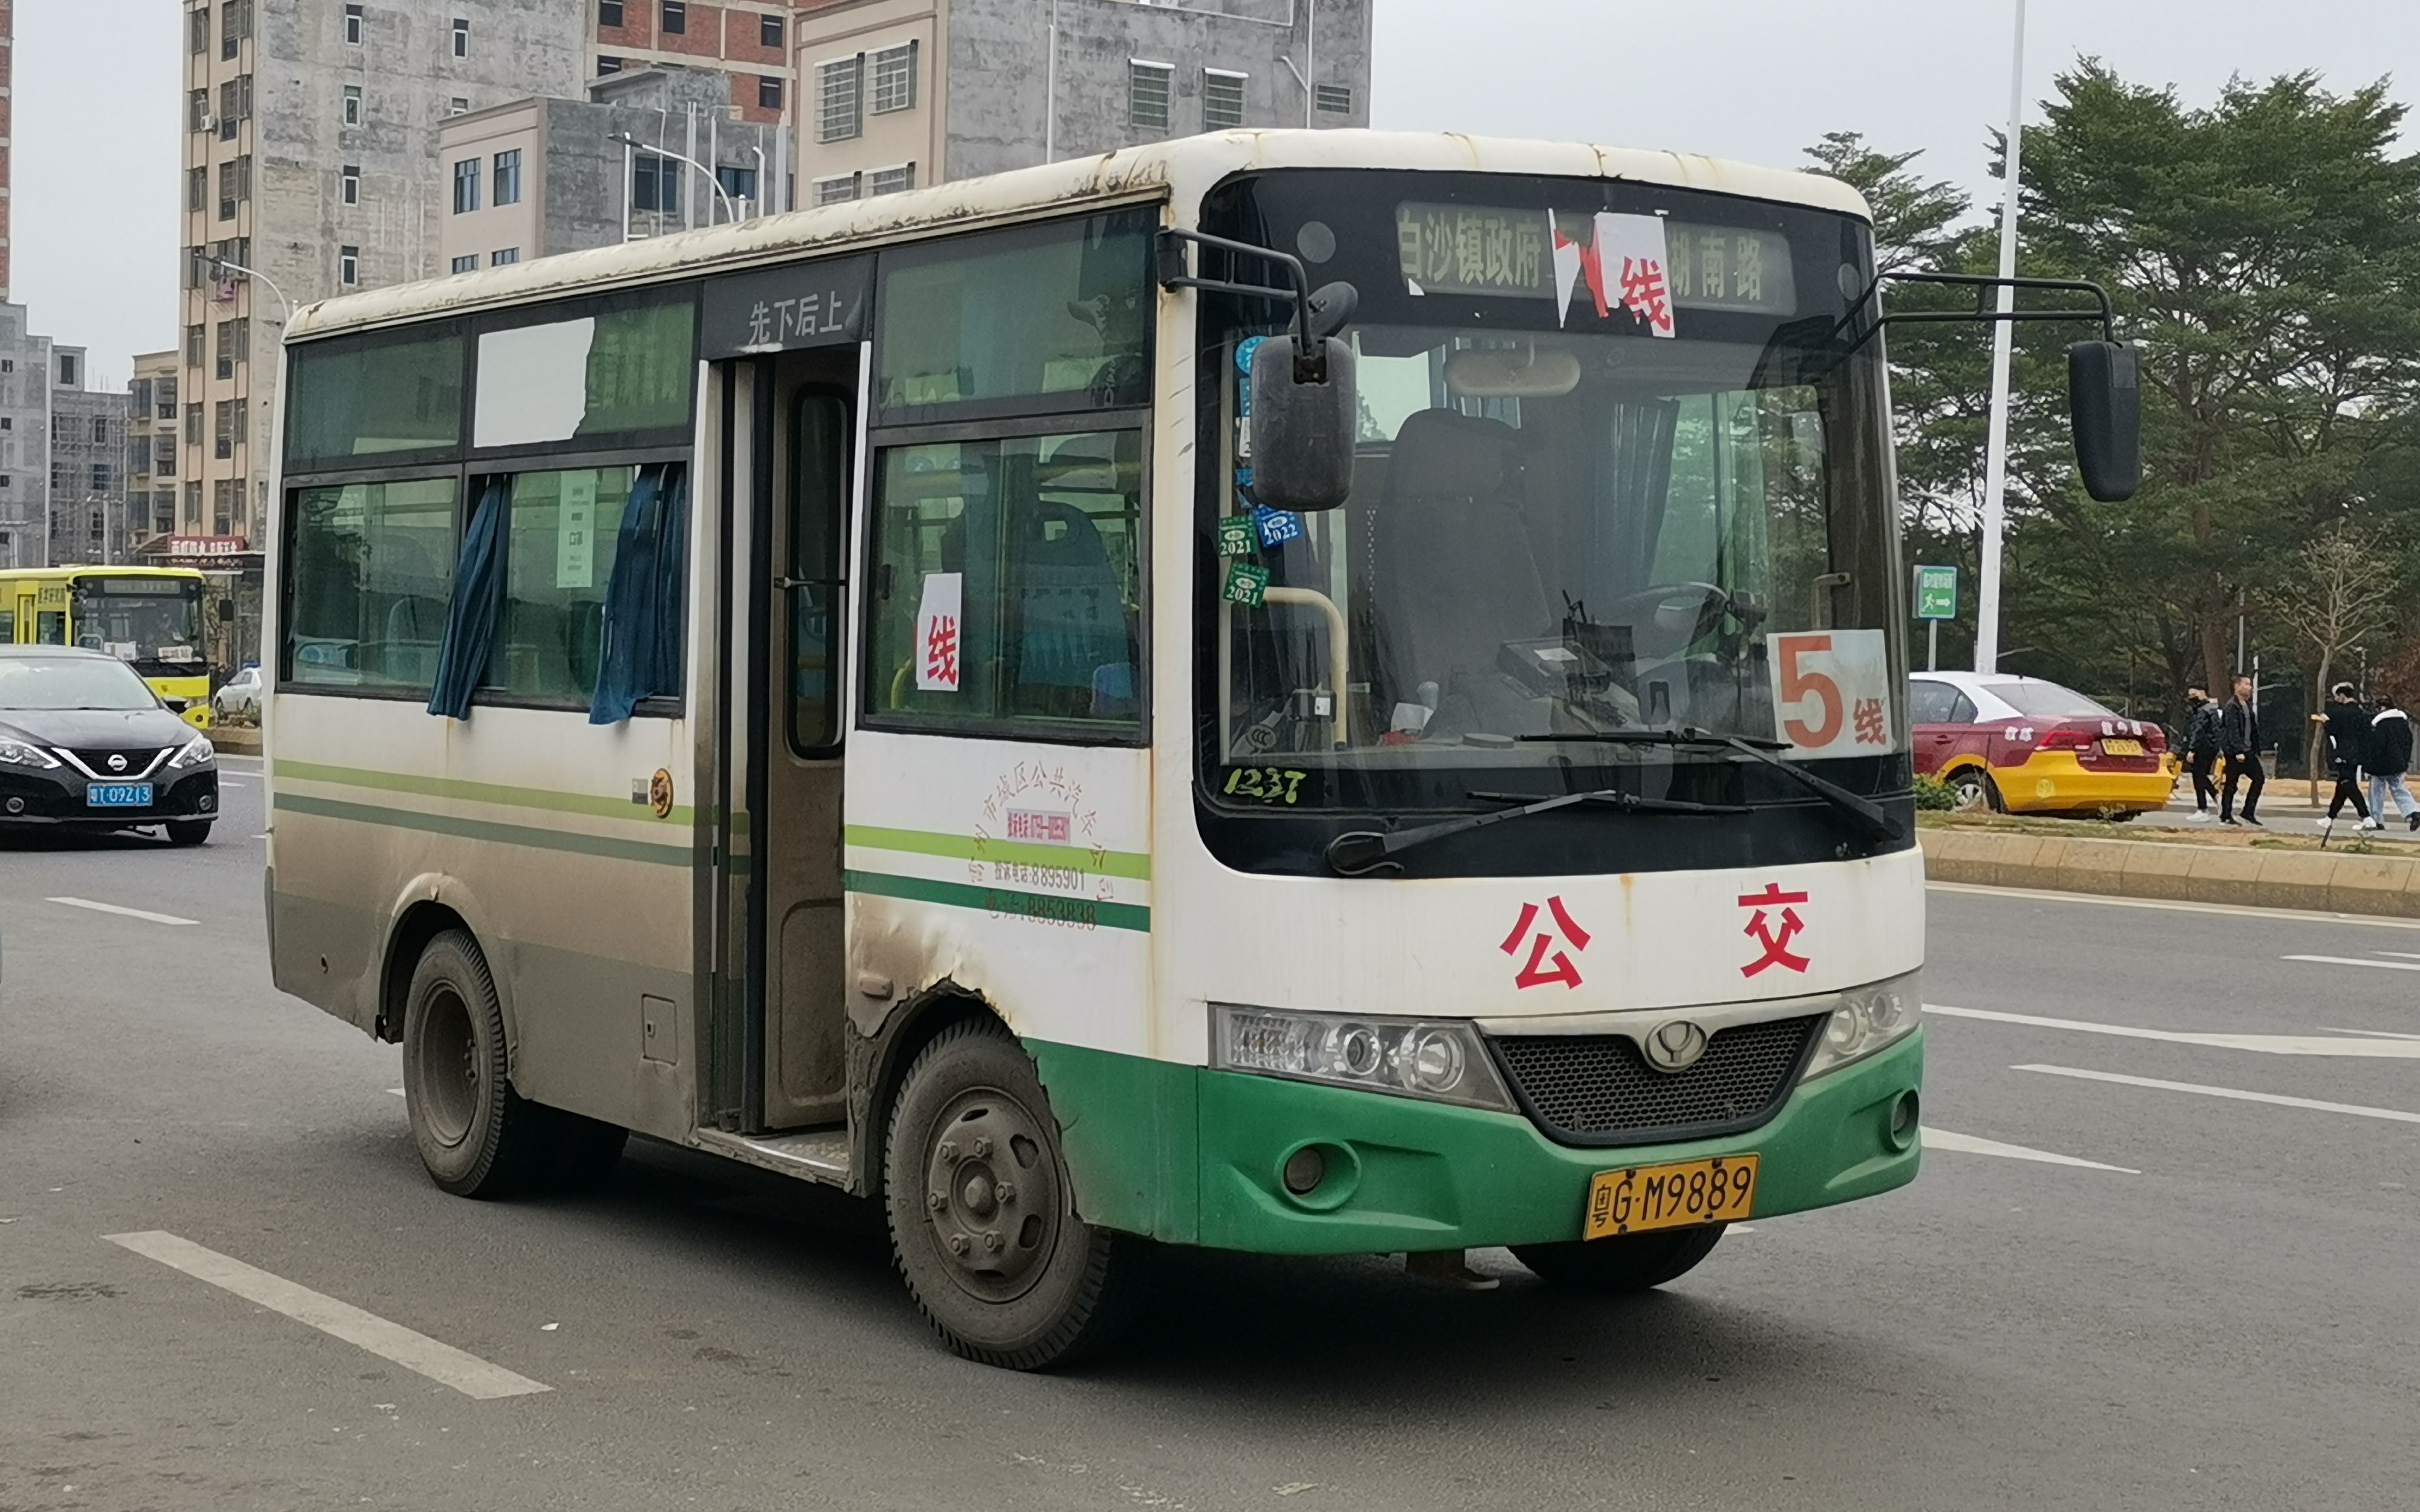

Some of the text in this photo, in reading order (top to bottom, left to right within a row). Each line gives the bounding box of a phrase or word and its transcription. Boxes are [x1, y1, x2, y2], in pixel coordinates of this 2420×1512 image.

[1398, 210, 1541, 288] 白沙镇政府
[749, 290, 843, 345] 先下后上
[1620, 256, 1672, 331] 线
[1220, 539, 1251, 555] 2021
[1226, 585, 1258, 604] 2021
[927, 615, 956, 686] 线
[1778, 635, 1886, 748] 5线
[1499, 882, 1811, 990] 公交
[1592, 1165, 1751, 1228] 粤G·M9889
